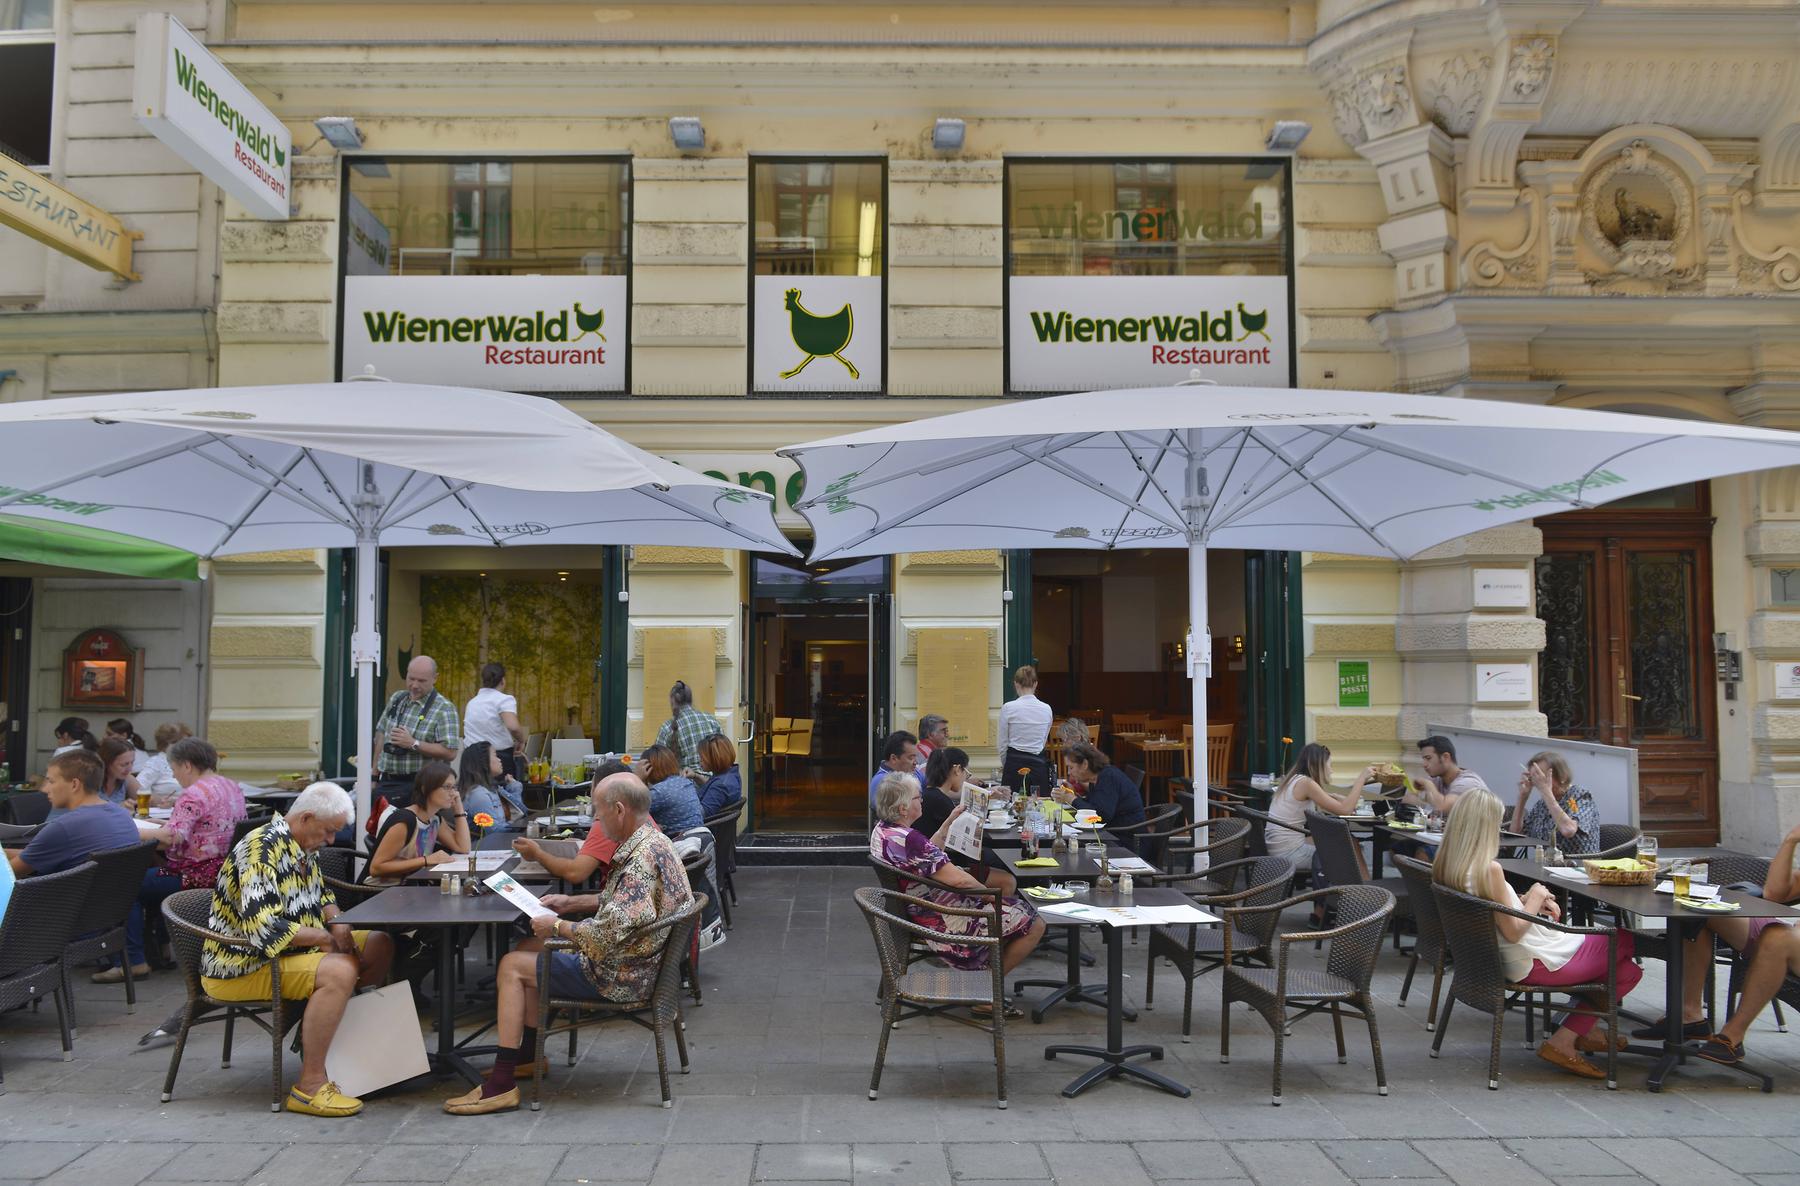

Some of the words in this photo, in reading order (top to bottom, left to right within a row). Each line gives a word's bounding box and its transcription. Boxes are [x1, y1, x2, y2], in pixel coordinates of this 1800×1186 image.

[174, 47, 271, 164] Wienerwald
[234, 141, 286, 199] Restaurant
[1031, 201, 1263, 241] Wienerwald
[363, 310, 569, 343] Wienerwald
[1030, 310, 1234, 343] Wienerwald
[485, 345, 606, 365] Restaurant
[1152, 345, 1271, 365] Restaurant
